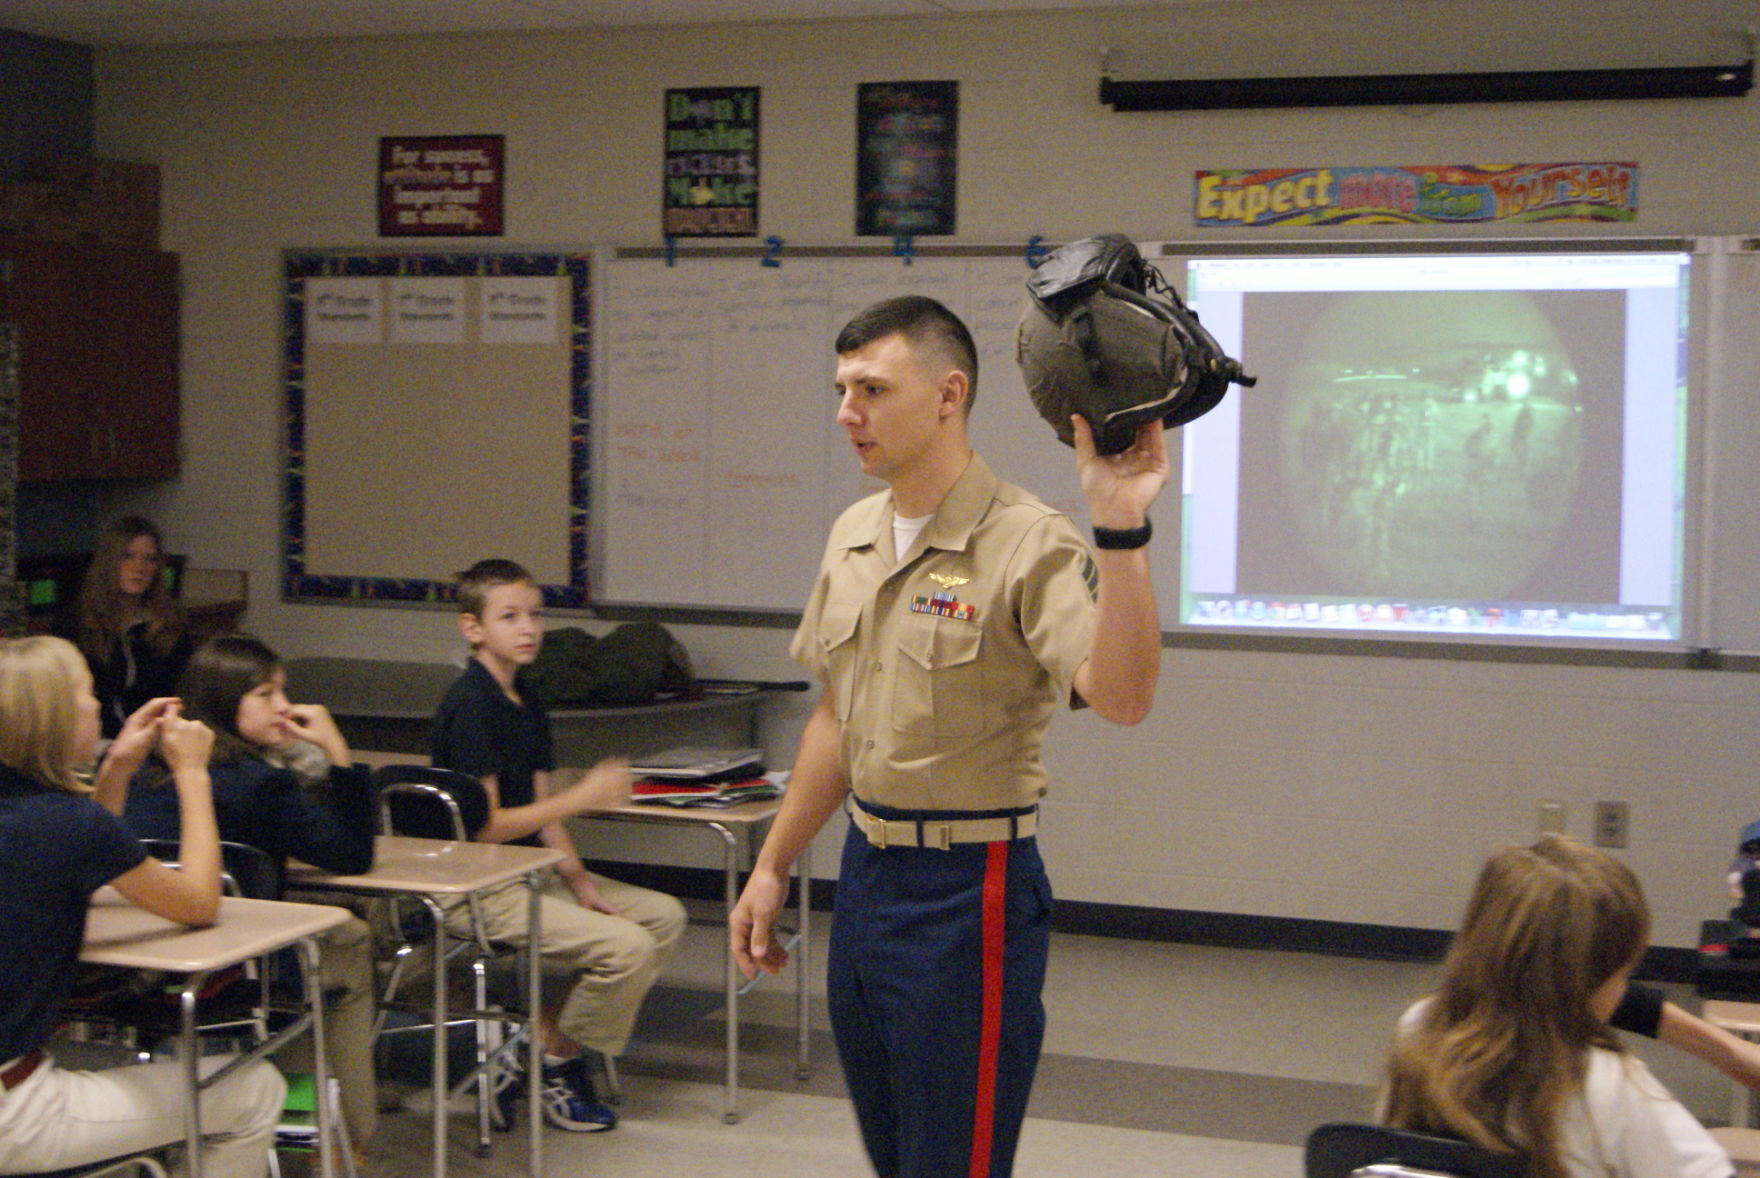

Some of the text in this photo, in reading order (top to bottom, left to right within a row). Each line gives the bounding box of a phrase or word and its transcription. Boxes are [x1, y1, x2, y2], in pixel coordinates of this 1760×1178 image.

[1196, 169, 1334, 224] Expect
[760, 235, 784, 268] 2
[893, 236, 916, 267] 4
